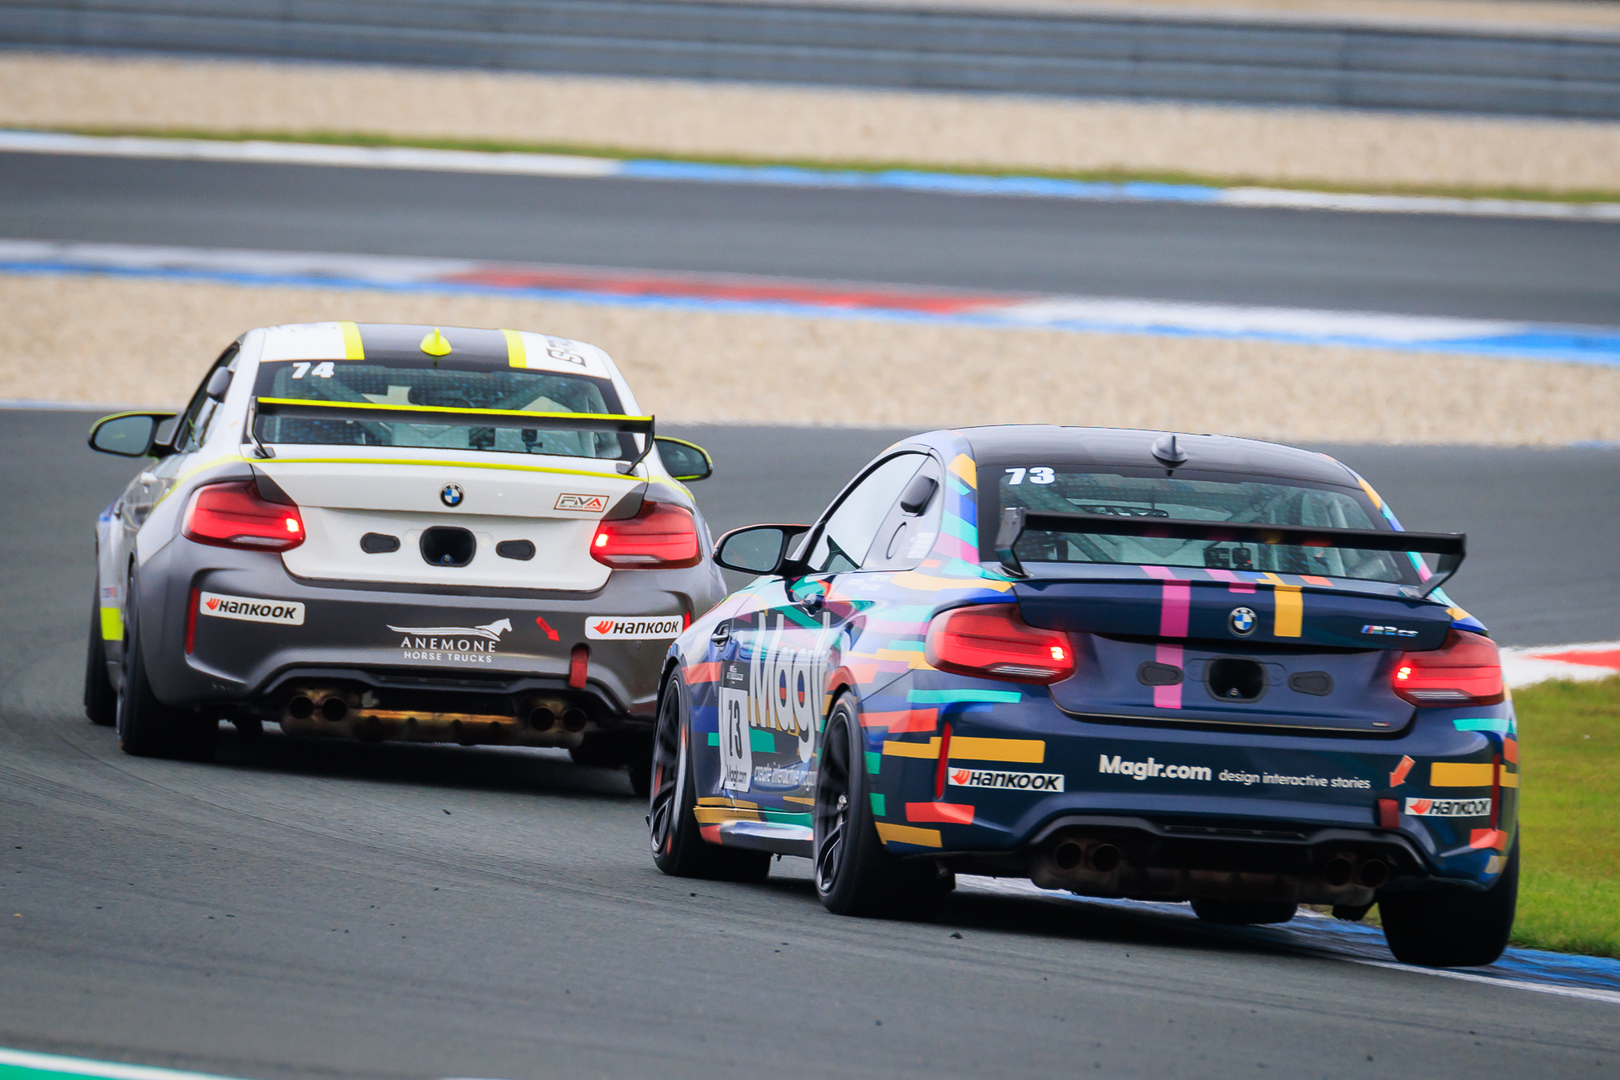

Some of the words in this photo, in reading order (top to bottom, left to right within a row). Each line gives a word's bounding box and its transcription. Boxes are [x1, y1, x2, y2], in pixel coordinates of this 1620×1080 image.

[292, 362, 335, 379] 74
[1005, 466, 1056, 485] 73
[401, 636, 496, 653] ANEMONE
[404, 651, 442, 661] HORSE
[448, 653, 493, 663] TRUCKS
[1099, 754, 1212, 781] Maglr.com
[1218, 769, 1260, 786] design
[1263, 771, 1328, 787] interactive
[1331, 776, 1371, 789] stories
